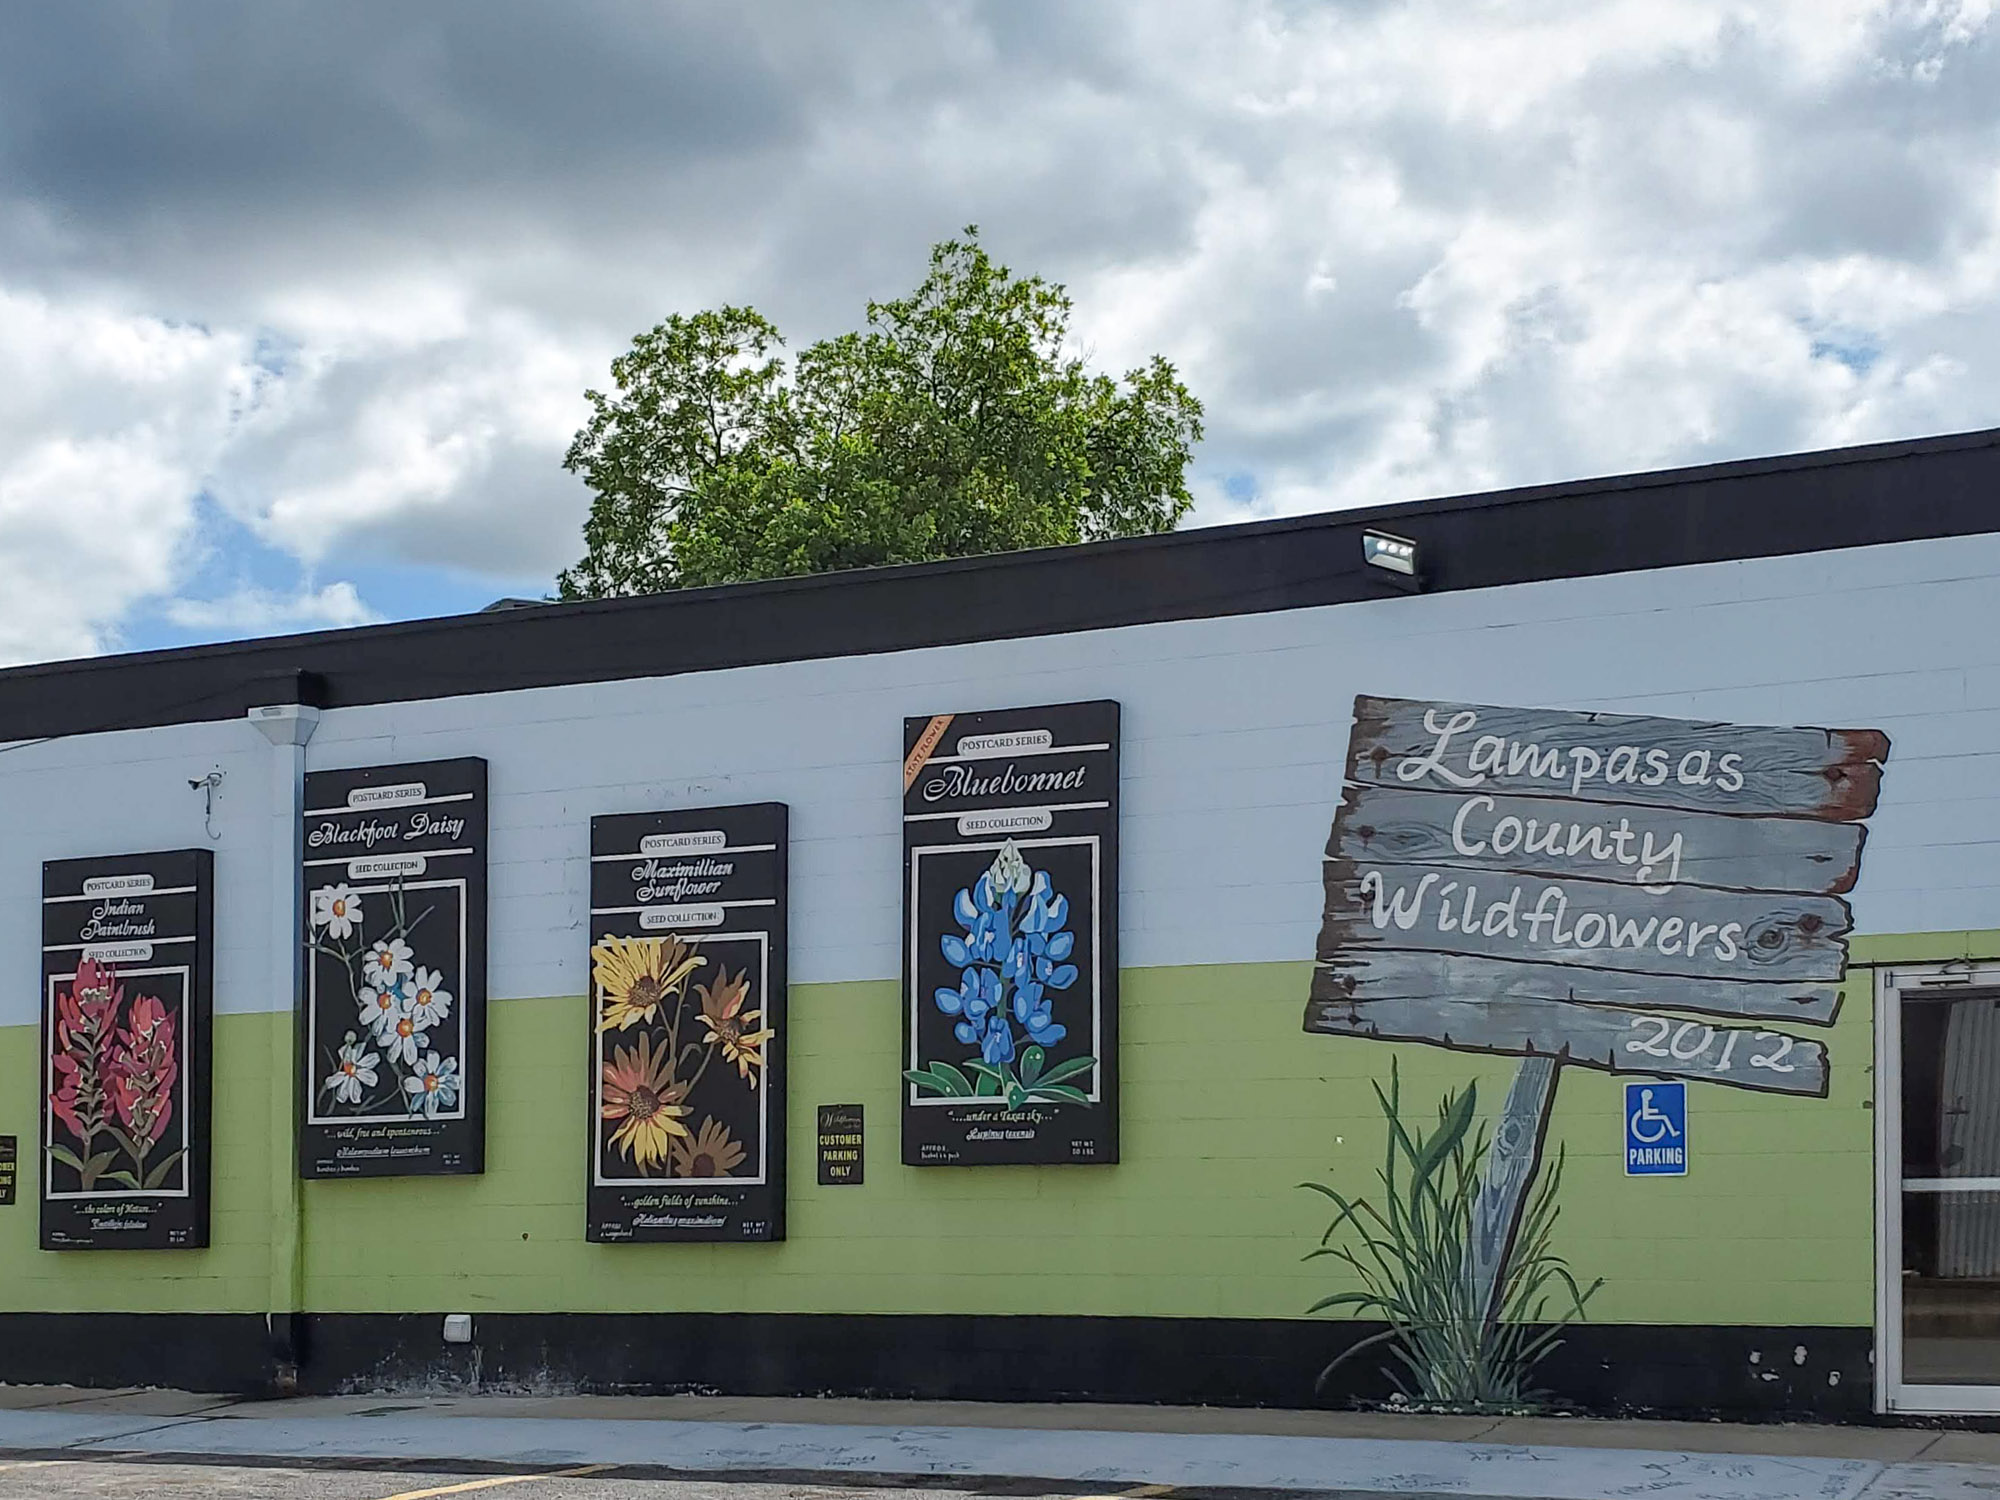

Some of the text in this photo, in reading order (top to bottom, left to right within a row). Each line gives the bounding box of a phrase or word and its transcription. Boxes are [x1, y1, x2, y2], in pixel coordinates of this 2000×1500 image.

[962, 734, 1048, 750] POSTCARD SERIES
[1397, 708, 1745, 795] Lampasas
[922, 763, 1086, 802] Bluebonnet
[353, 788, 422, 803] POSTCARD SERIES
[308, 811, 465, 849] Blackfoot Daisy
[966, 815, 1044, 830] SEED COLLECTION
[644, 835, 722, 849] POSTCARD SERIES
[1451, 796, 1683, 896] County
[355, 860, 419, 873] SEED COLLECTION
[631, 857, 734, 881] Maximillian
[86, 877, 151, 891] POSTCARD SERIES
[636, 877, 722, 902] Sunflower
[92, 898, 145, 920] Indian
[1359, 870, 1744, 962] Wildflowers
[647, 911, 718, 924] SEED COLLECTION
[80, 918, 155, 940] Paintbrush
[105, 947, 147, 959] COLLECTION
[1625, 1016, 1795, 1073] 2012
[1000, 1110, 1026, 1122] Texas
[371, 1126, 386, 1138] and
[820, 1134, 862, 1146] CUSTOMER
[823, 1150, 858, 1161] PARKING
[1629, 1147, 1683, 1166] PARKING
[830, 1165, 851, 1177] ONLY
[659, 1194, 683, 1208] fields
[684, 1194, 694, 1208] of
[117, 1203, 125, 1216] of
